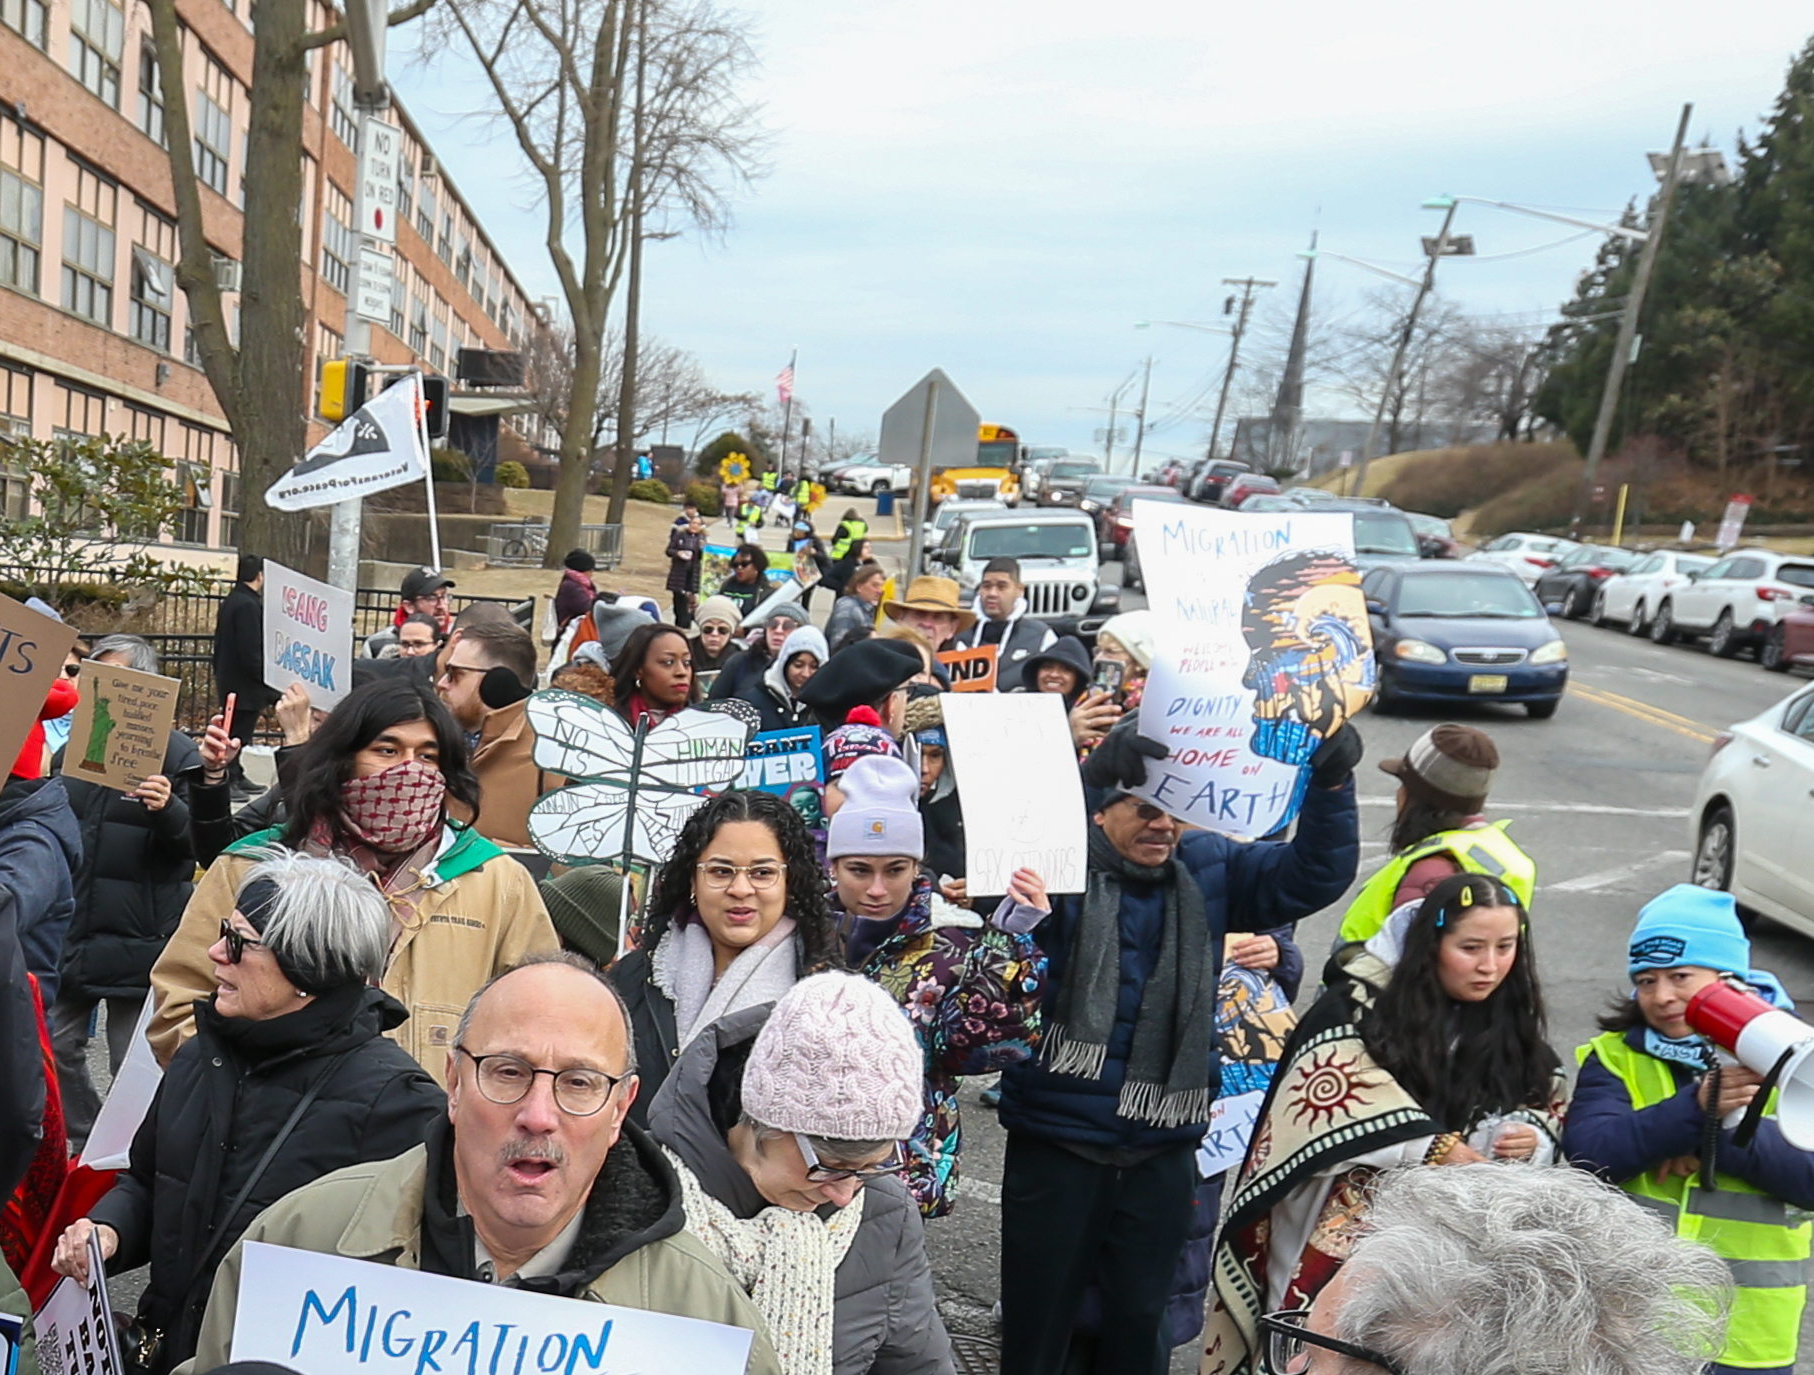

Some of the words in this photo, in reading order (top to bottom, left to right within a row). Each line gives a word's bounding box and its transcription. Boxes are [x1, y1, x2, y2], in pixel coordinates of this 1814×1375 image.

[375, 130, 390, 155] NO
[370, 158, 392, 180] TURN
[1162, 519, 1292, 560] MIGRATION
[951, 656, 990, 683] ND
[1167, 694, 1243, 721] DIGNITY
[553, 716, 589, 749] NO
[1170, 724, 1191, 738] WE
[1195, 725, 1222, 739] ARE
[1225, 725, 1245, 739] ALL
[559, 743, 588, 776] IS
[677, 737, 743, 760] HUMAN
[747, 734, 813, 758] RANT
[109, 751, 139, 769] free
[733, 752, 817, 790] WER
[1167, 747, 1240, 768] HOME
[1242, 761, 1264, 777] ON
[1152, 772, 1292, 826] EARTH
[1210, 1103, 1225, 1120] ON
[1201, 1102, 1262, 1159] RTH
